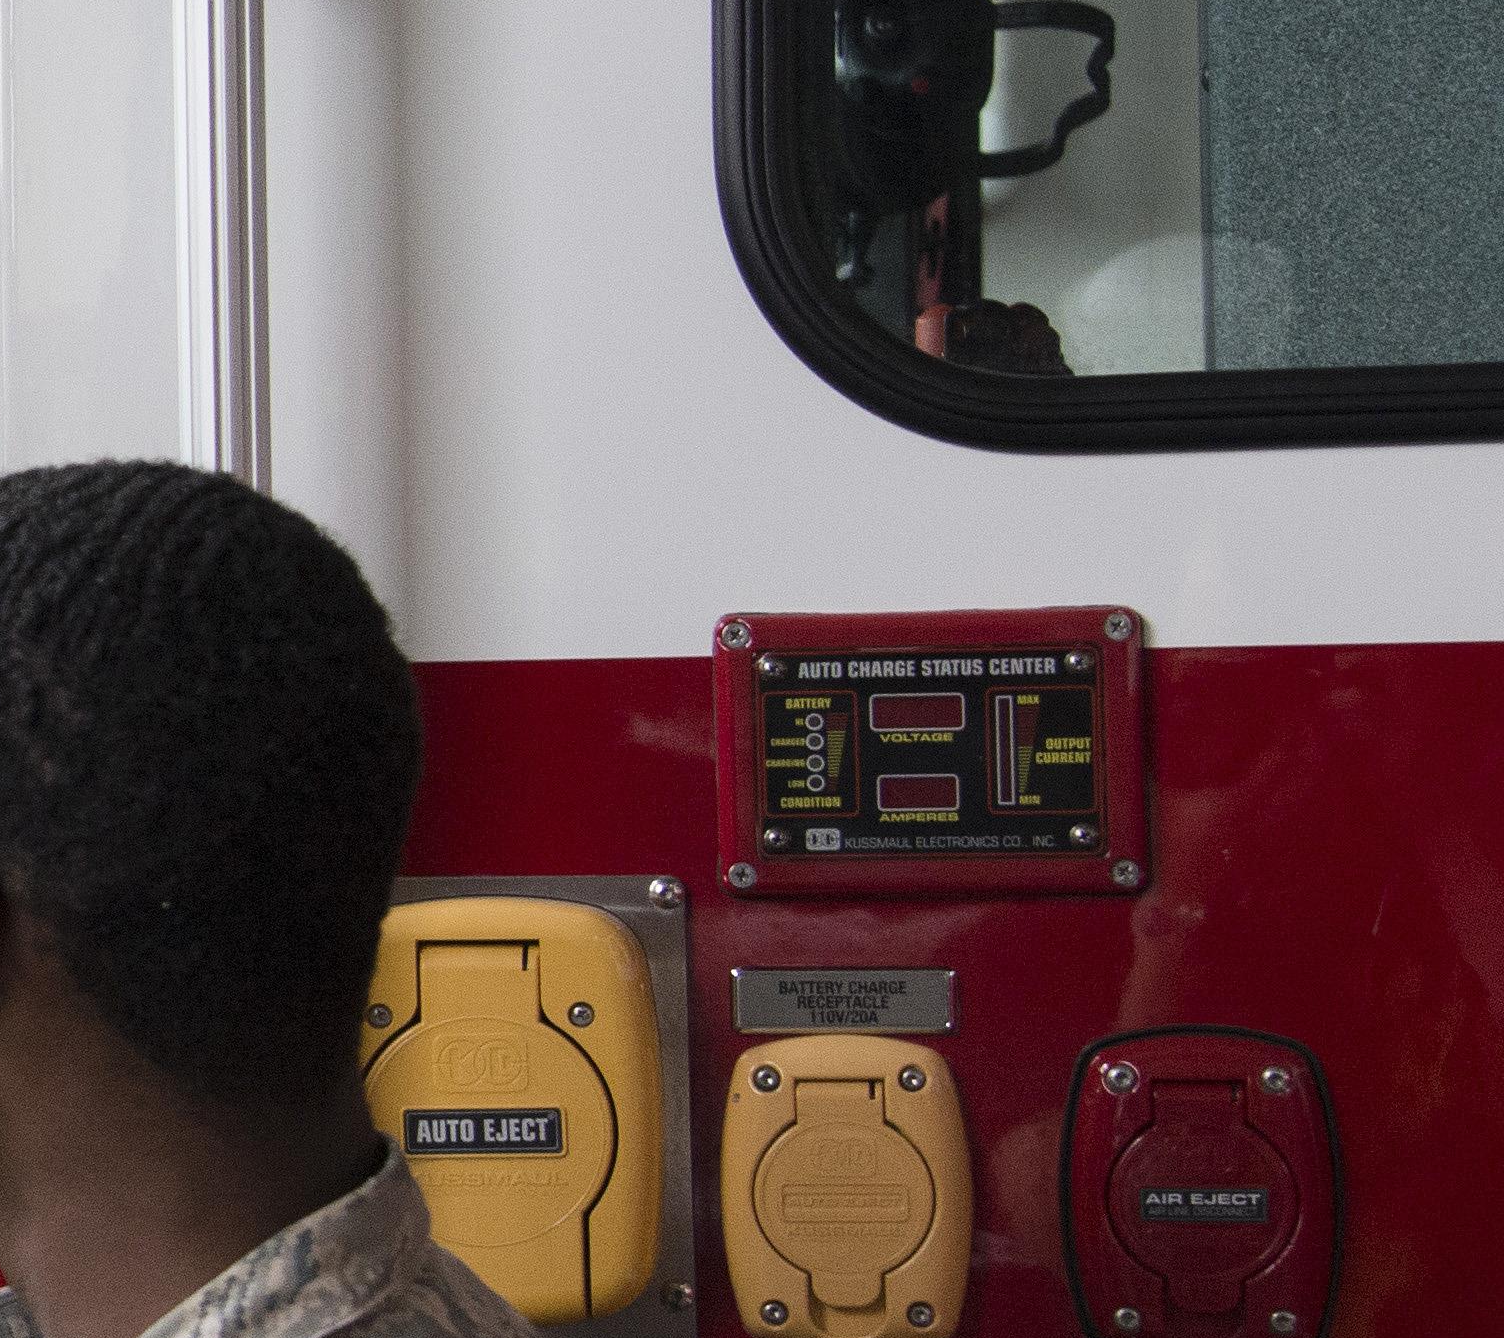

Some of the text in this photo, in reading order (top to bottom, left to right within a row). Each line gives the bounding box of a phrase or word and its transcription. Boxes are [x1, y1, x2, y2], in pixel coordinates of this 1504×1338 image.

[798, 657, 1056, 679] AUTO CHARGE STATUS CENTER
[785, 697, 832, 709] BATTERY
[1016, 694, 1040, 705] MAX
[879, 732, 954, 743] VOLTAGE
[1045, 737, 1092, 750] OUTPUT
[1035, 751, 1092, 764] CURRENT
[780, 796, 841, 809] CONDITION
[1018, 795, 1041, 806] MIN
[879, 812, 959, 822] AMPERES
[845, 836, 912, 849] KUSSMAUL
[915, 835, 999, 849] ELECTRONICS
[778, 980, 907, 996] BATTERY CHARGE
[796, 995, 890, 1010] RECEPTACLE
[809, 1009, 879, 1025] 110V/20A
[417, 1117, 549, 1142] AUTO EJECT
[1145, 1193, 1261, 1205] AIR EJECT
